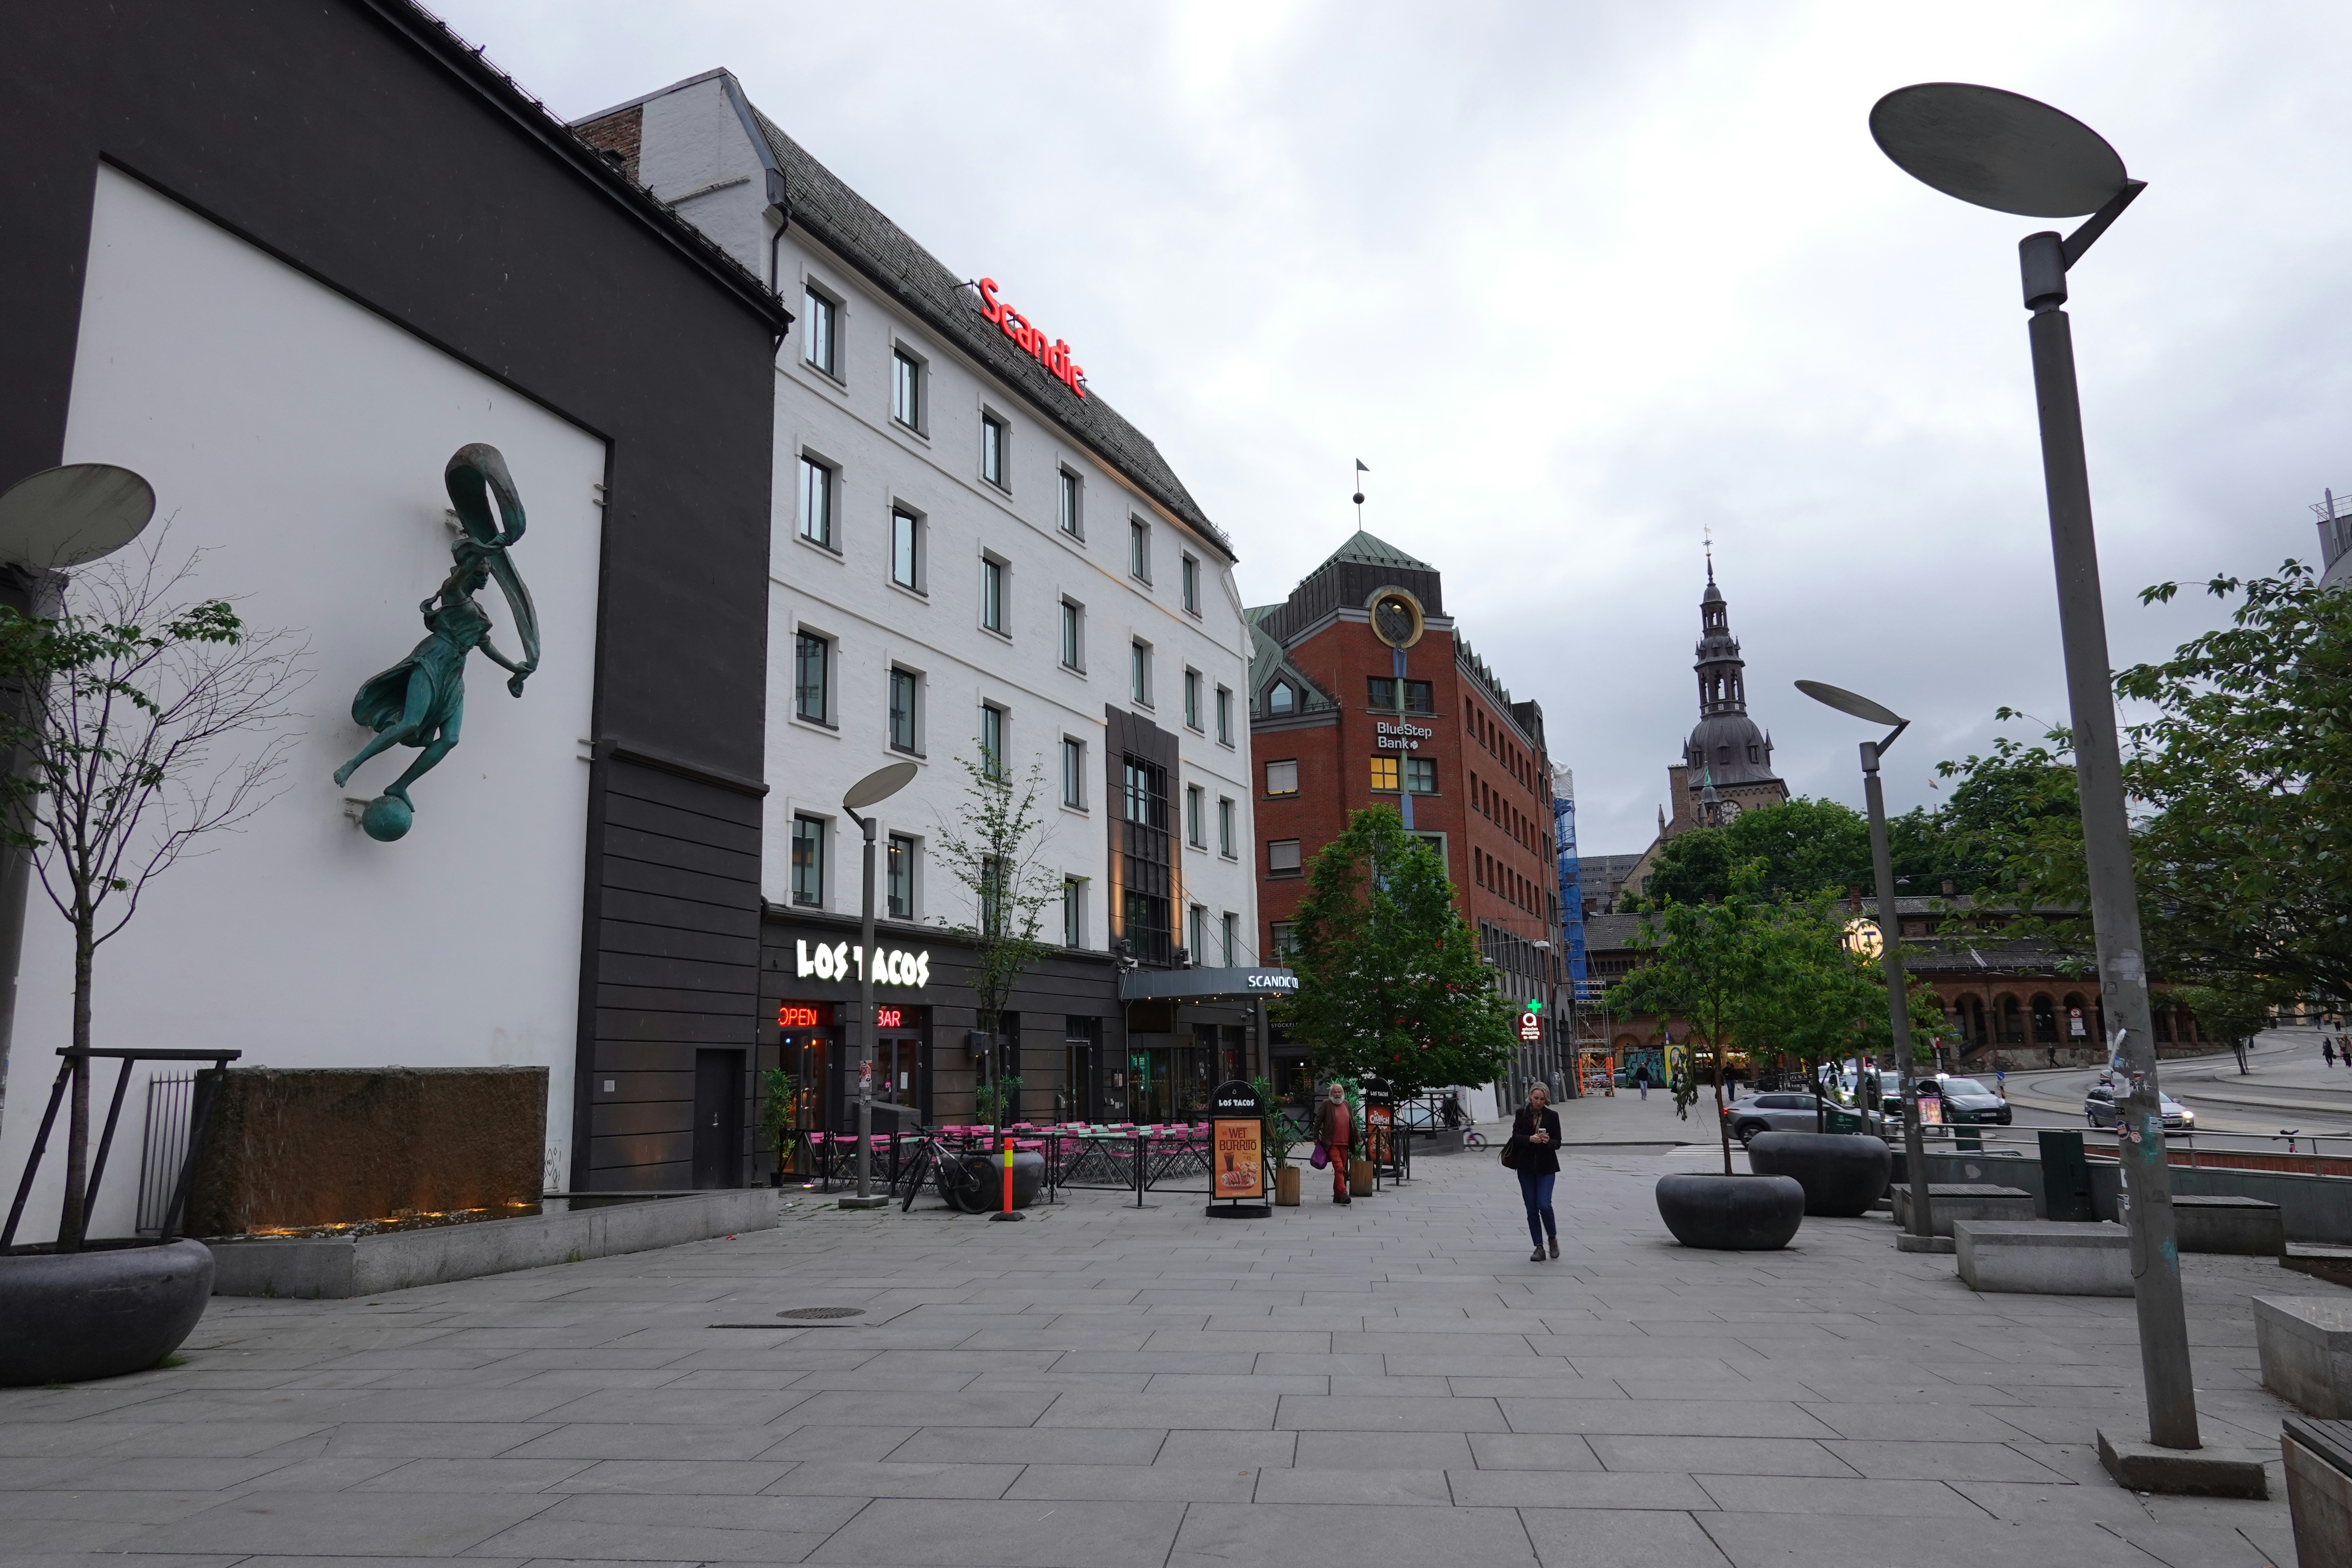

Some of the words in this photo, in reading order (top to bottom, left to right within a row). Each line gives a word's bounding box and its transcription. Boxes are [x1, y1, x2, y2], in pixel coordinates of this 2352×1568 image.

[980, 277, 1084, 398] Scandic
[1377, 722, 1432, 739] BlueStep
[1378, 736, 1409, 749] Bank
[797, 939, 848, 982] LOS
[853, 946, 930, 988] TACOS
[1248, 975, 1291, 987] SCANDIC
[778, 1008, 817, 1027] OPEN
[878, 1010, 900, 1027] BAR
[1369, 1114, 1389, 1124] CRUNCH
[1228, 1127, 1247, 1139] WET
[1219, 1139, 1257, 1151] BURRITO
